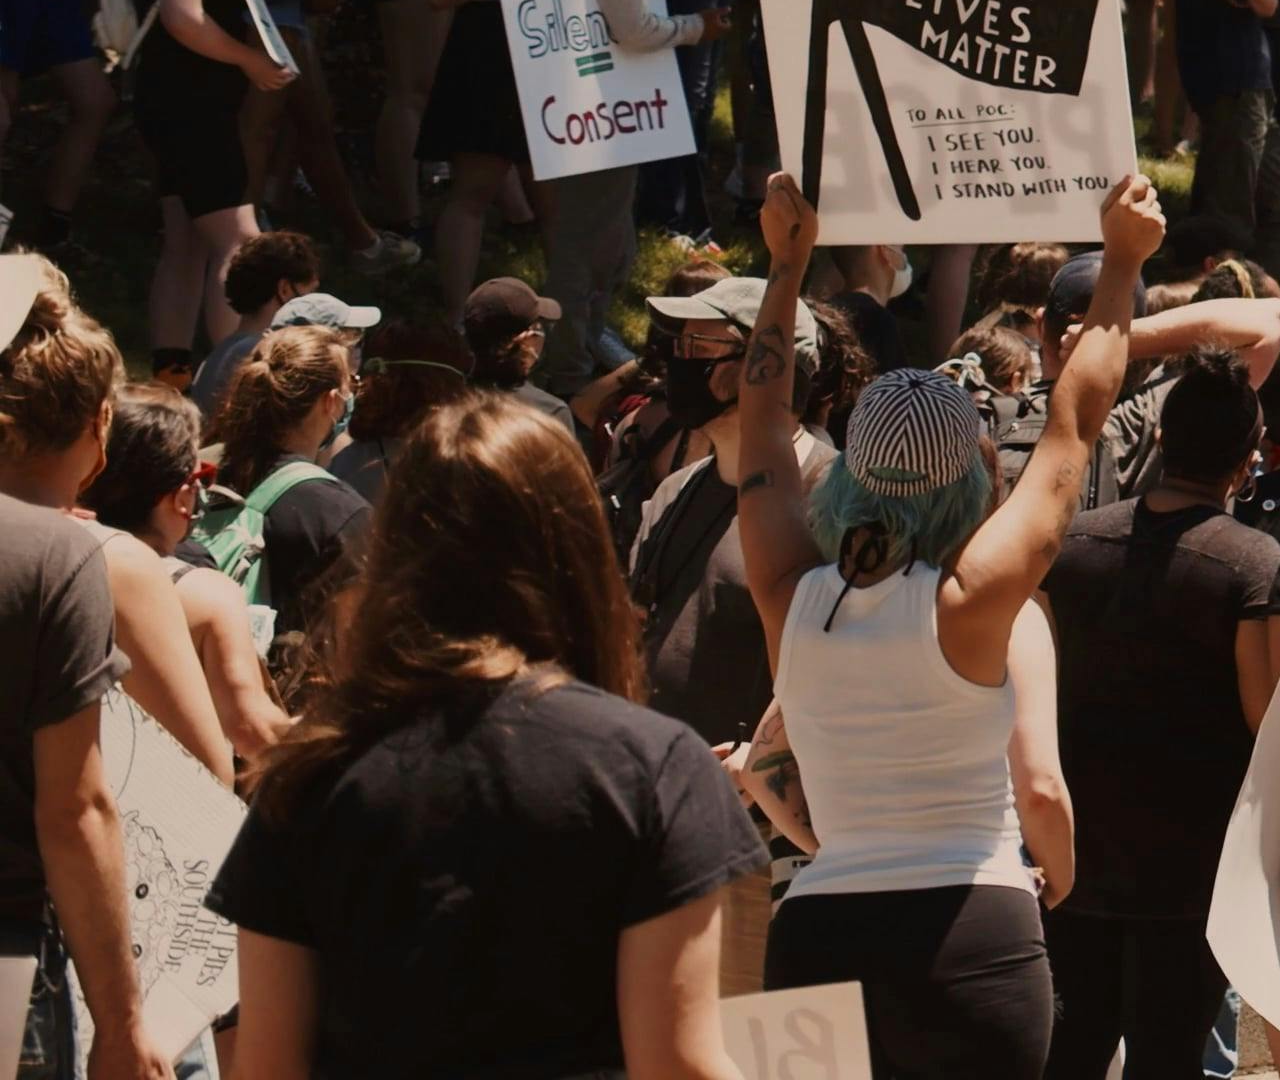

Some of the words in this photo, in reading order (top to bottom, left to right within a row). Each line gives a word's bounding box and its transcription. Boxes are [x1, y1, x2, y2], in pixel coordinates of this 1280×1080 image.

[919, 20, 1057, 89] MATTER
[541, 88, 668, 145] Consent
[905, 108, 927, 123] TO
[935, 107, 966, 121] ALL
[927, 135, 936, 152] I
[945, 133, 986, 152] SEE
[994, 126, 1041, 147] YOU.
[931, 161, 938, 175] I
[950, 156, 1002, 174] HEAR
[934, 183, 943, 200] I
[952, 181, 1015, 199] STAND
[1022, 178, 1067, 196] WITH
[165, 858, 210, 975] SOUTHSIDE
